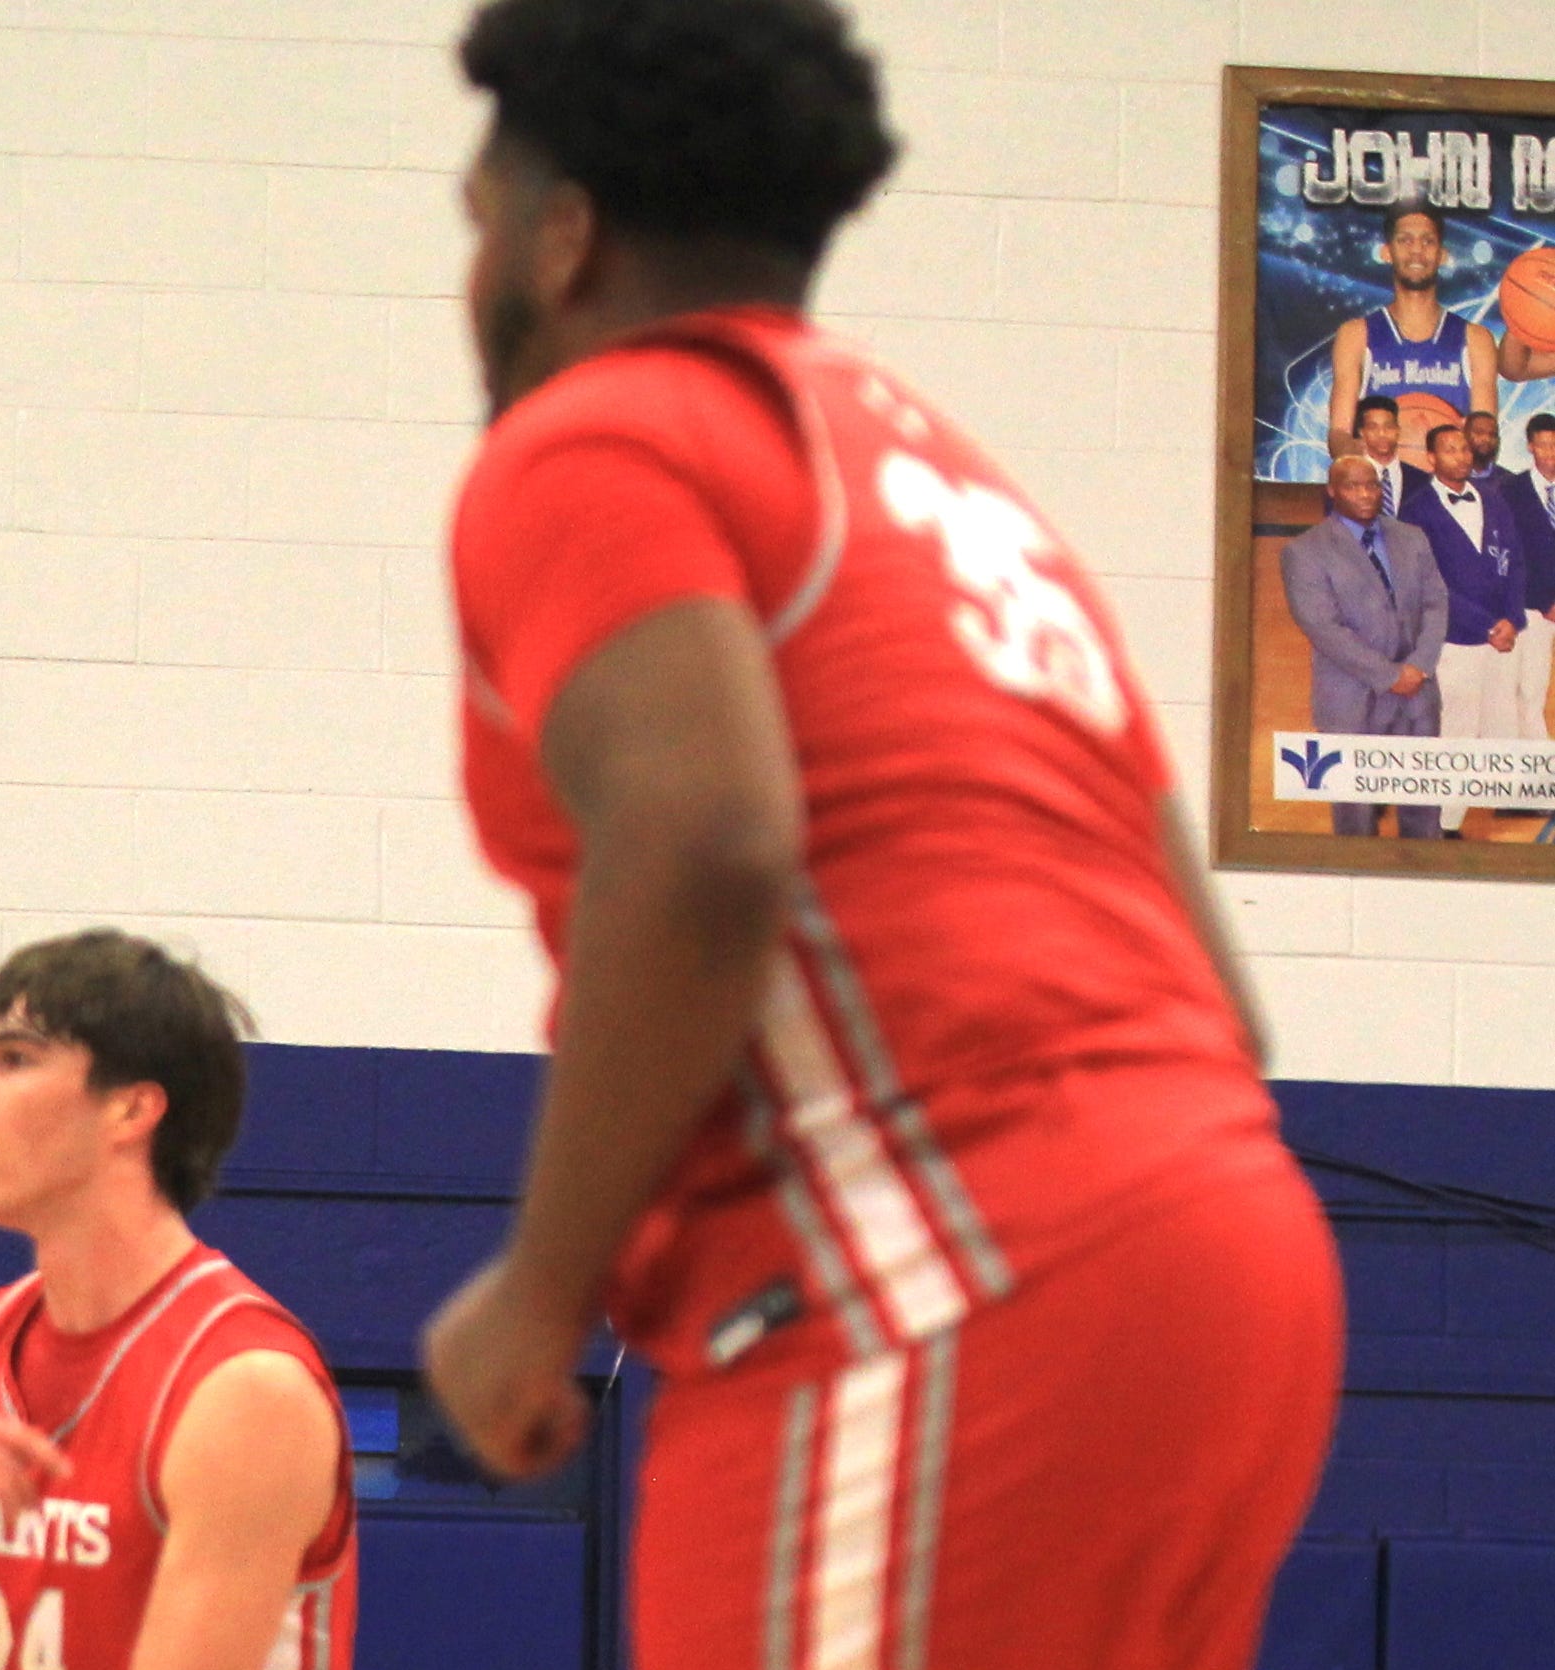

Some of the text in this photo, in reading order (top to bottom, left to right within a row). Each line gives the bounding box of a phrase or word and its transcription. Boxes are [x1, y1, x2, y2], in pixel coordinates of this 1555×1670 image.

[1303, 128, 1491, 210] JOHN
[1353, 750, 1404, 770] BON
[1412, 751, 1515, 773] SECOURS
[1355, 776, 1452, 796] SUPPORTS
[1458, 779, 1513, 797] JOHN
